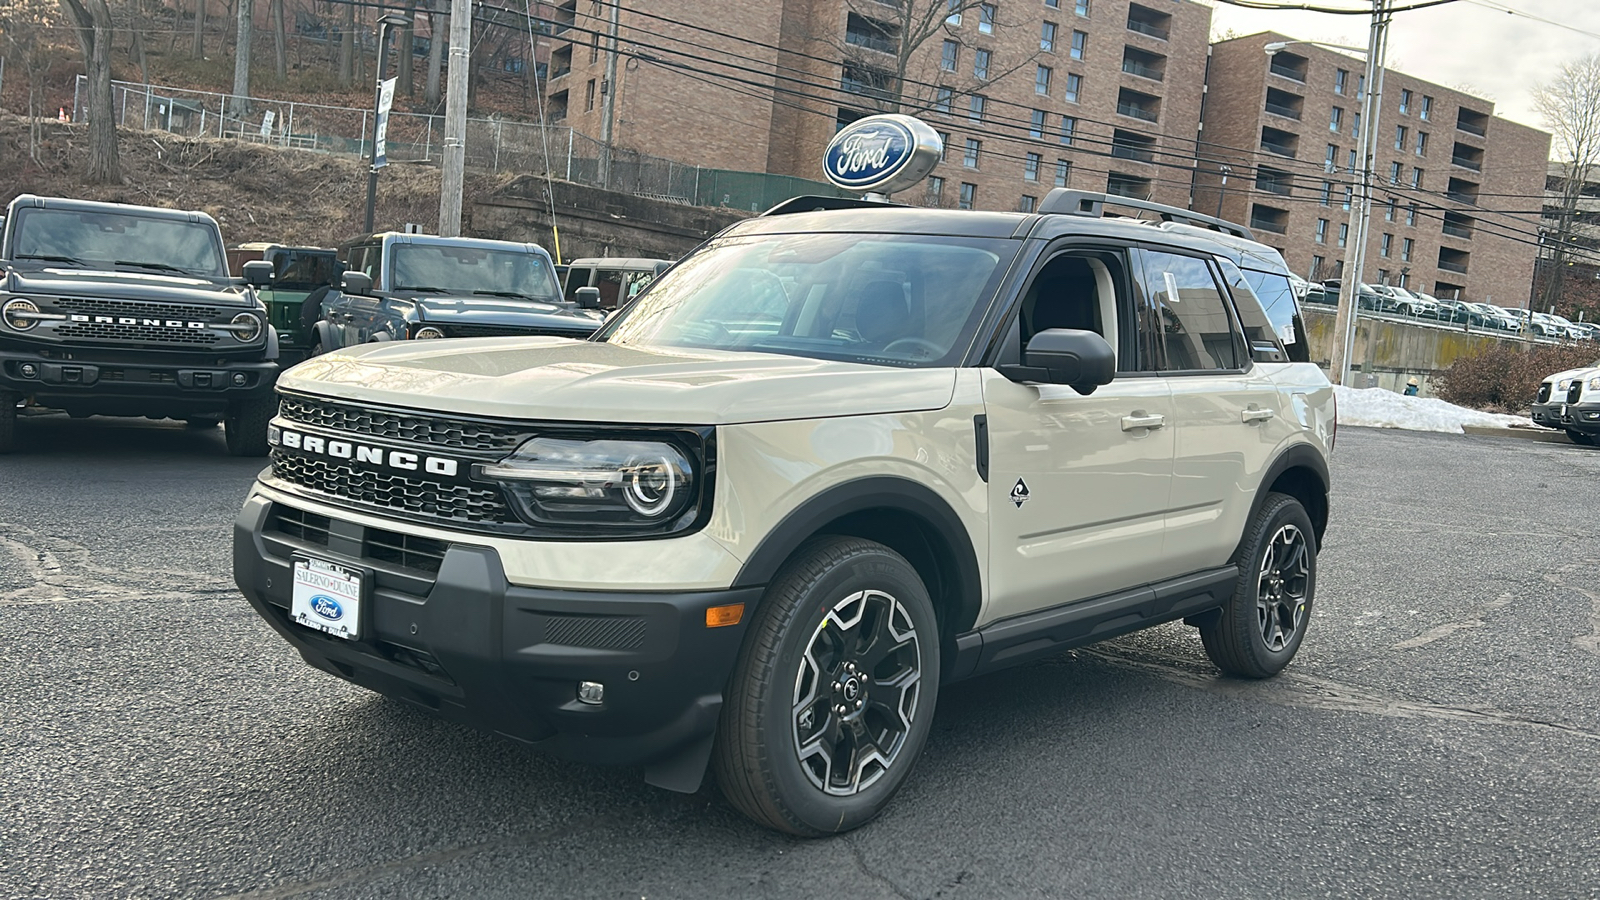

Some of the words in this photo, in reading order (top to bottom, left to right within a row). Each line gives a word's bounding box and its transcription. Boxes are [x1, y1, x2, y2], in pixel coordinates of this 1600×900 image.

[837, 130, 894, 176] Ford
[71, 314, 205, 329] BRONCO
[282, 430, 458, 477] BRONCO
[296, 569, 330, 588] SALERNO
[333, 579, 359, 598] DUANE
[315, 597, 338, 618] Ford
